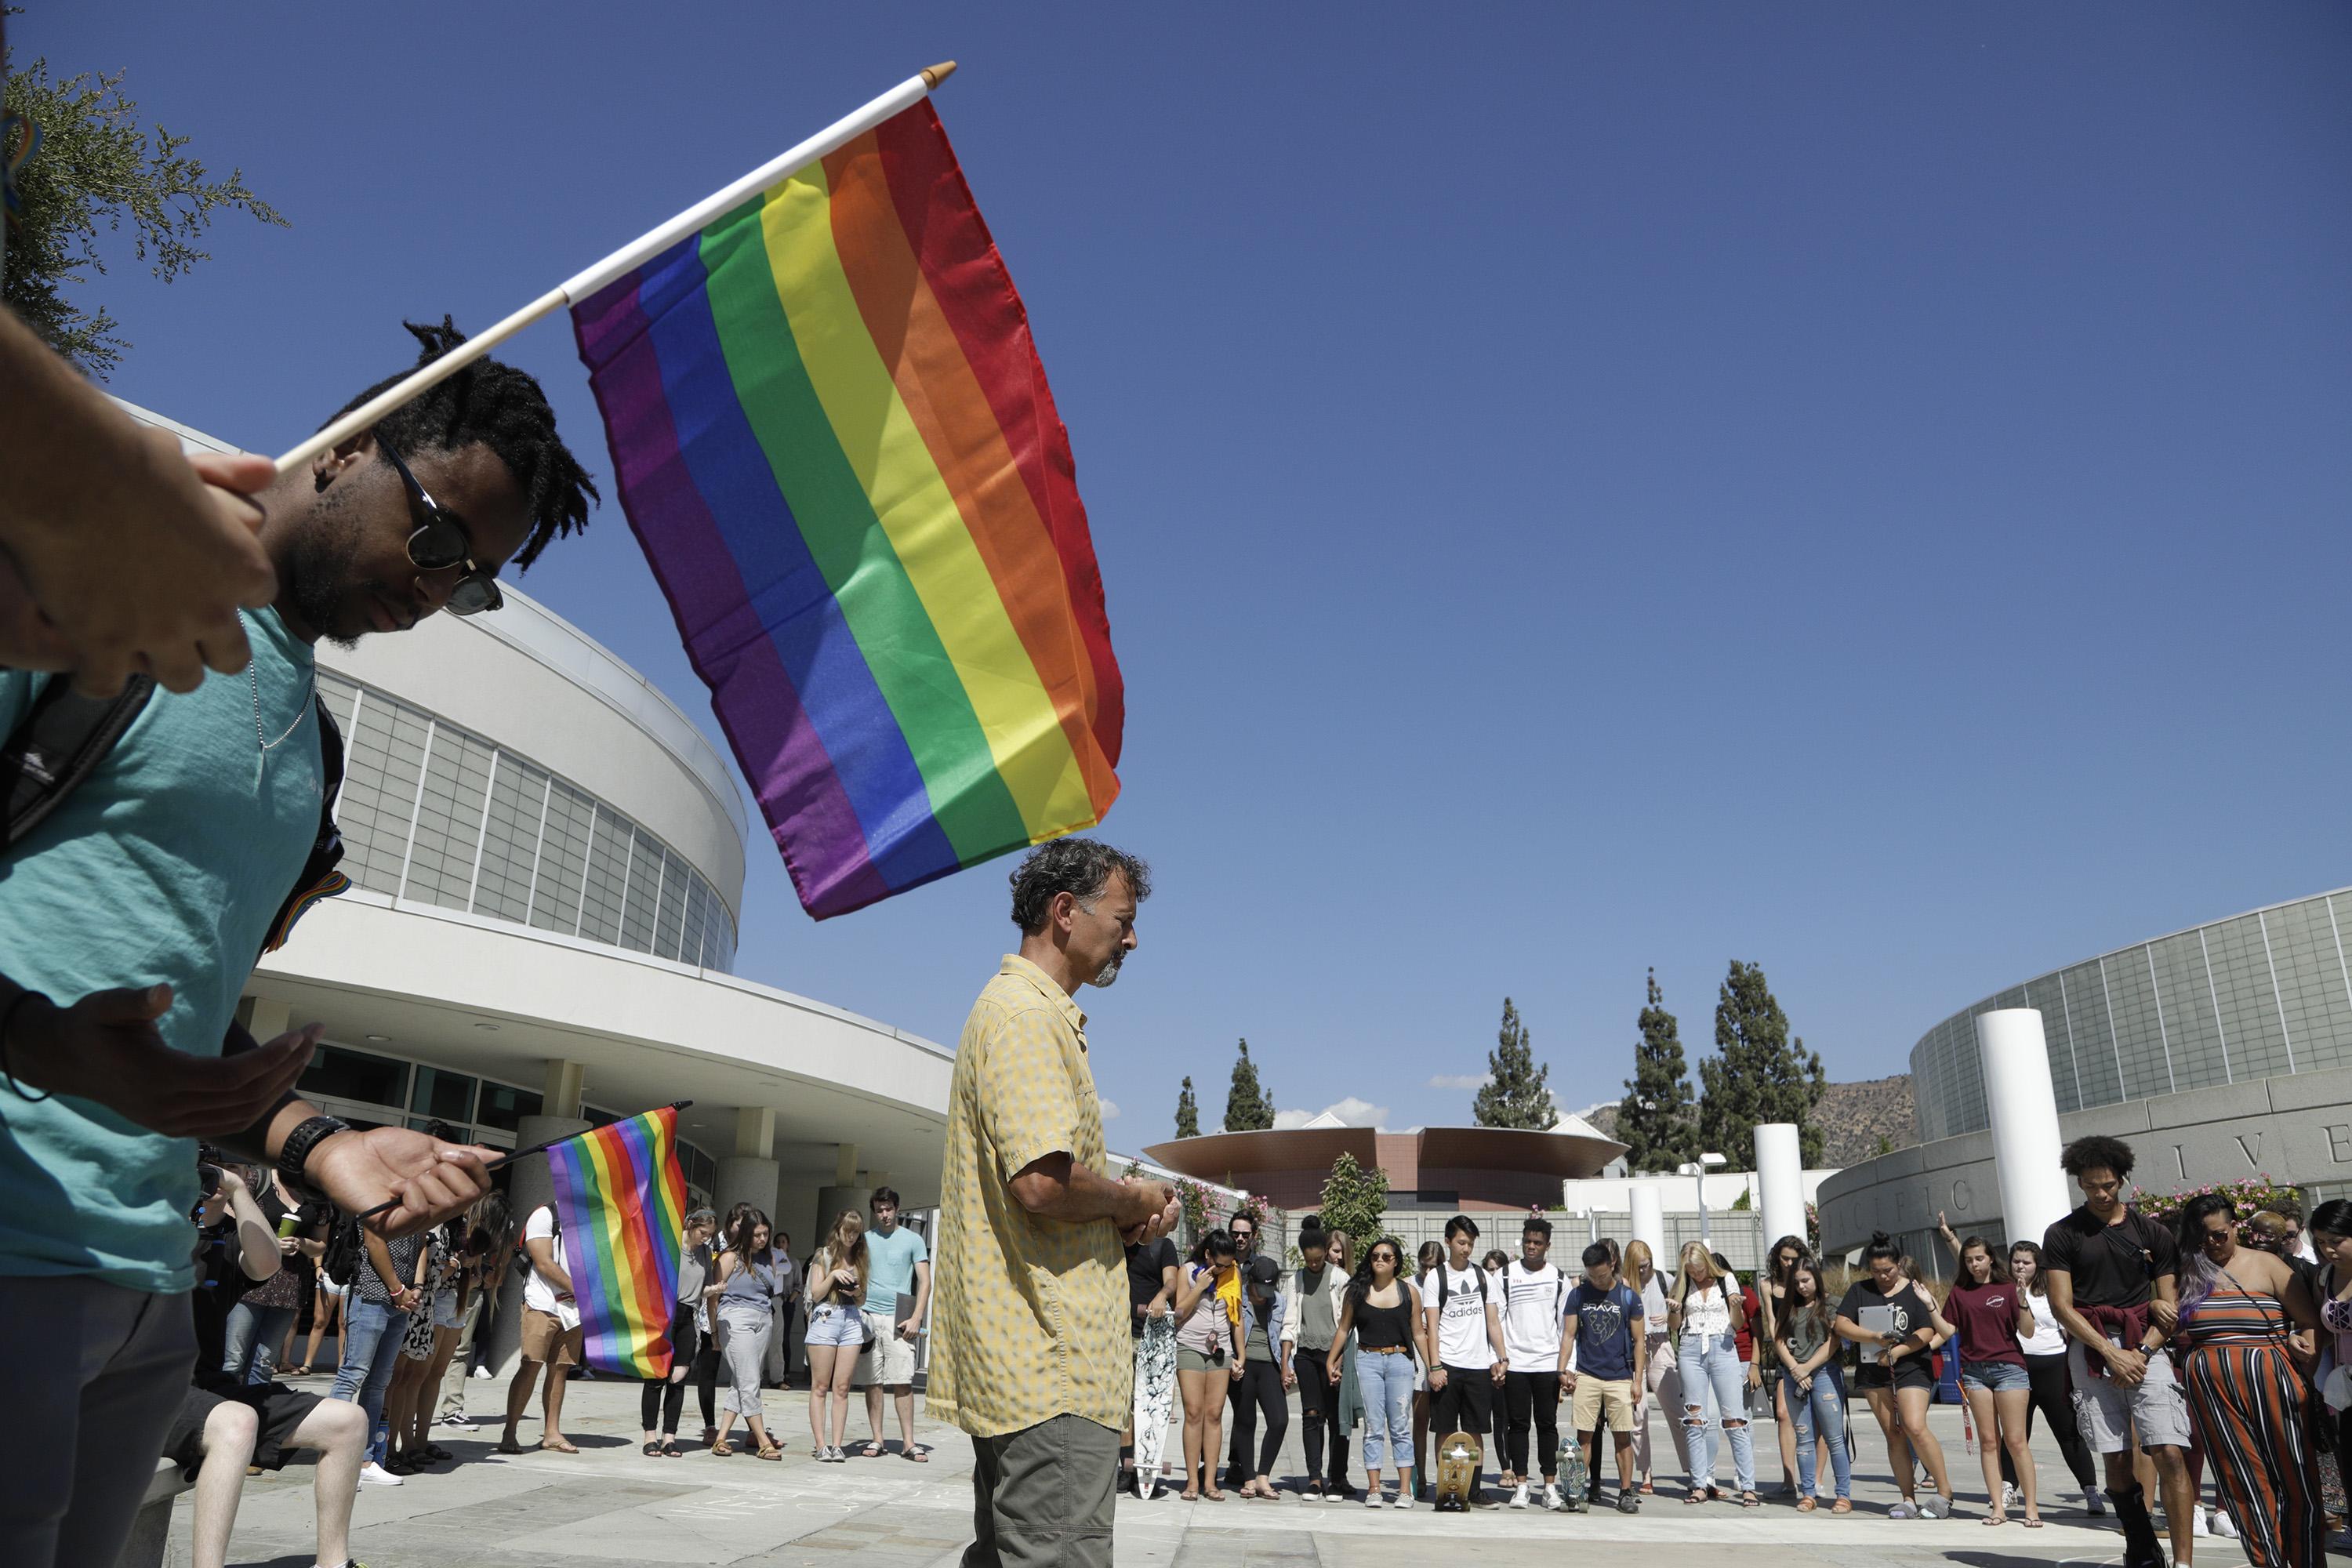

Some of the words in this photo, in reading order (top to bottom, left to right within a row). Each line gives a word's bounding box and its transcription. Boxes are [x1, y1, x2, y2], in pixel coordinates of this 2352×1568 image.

[1826, 1179, 1969, 1241] PACIFIC
[1449, 1306, 1483, 1318] adidas
[1582, 1303, 1621, 1313] BRAVE
